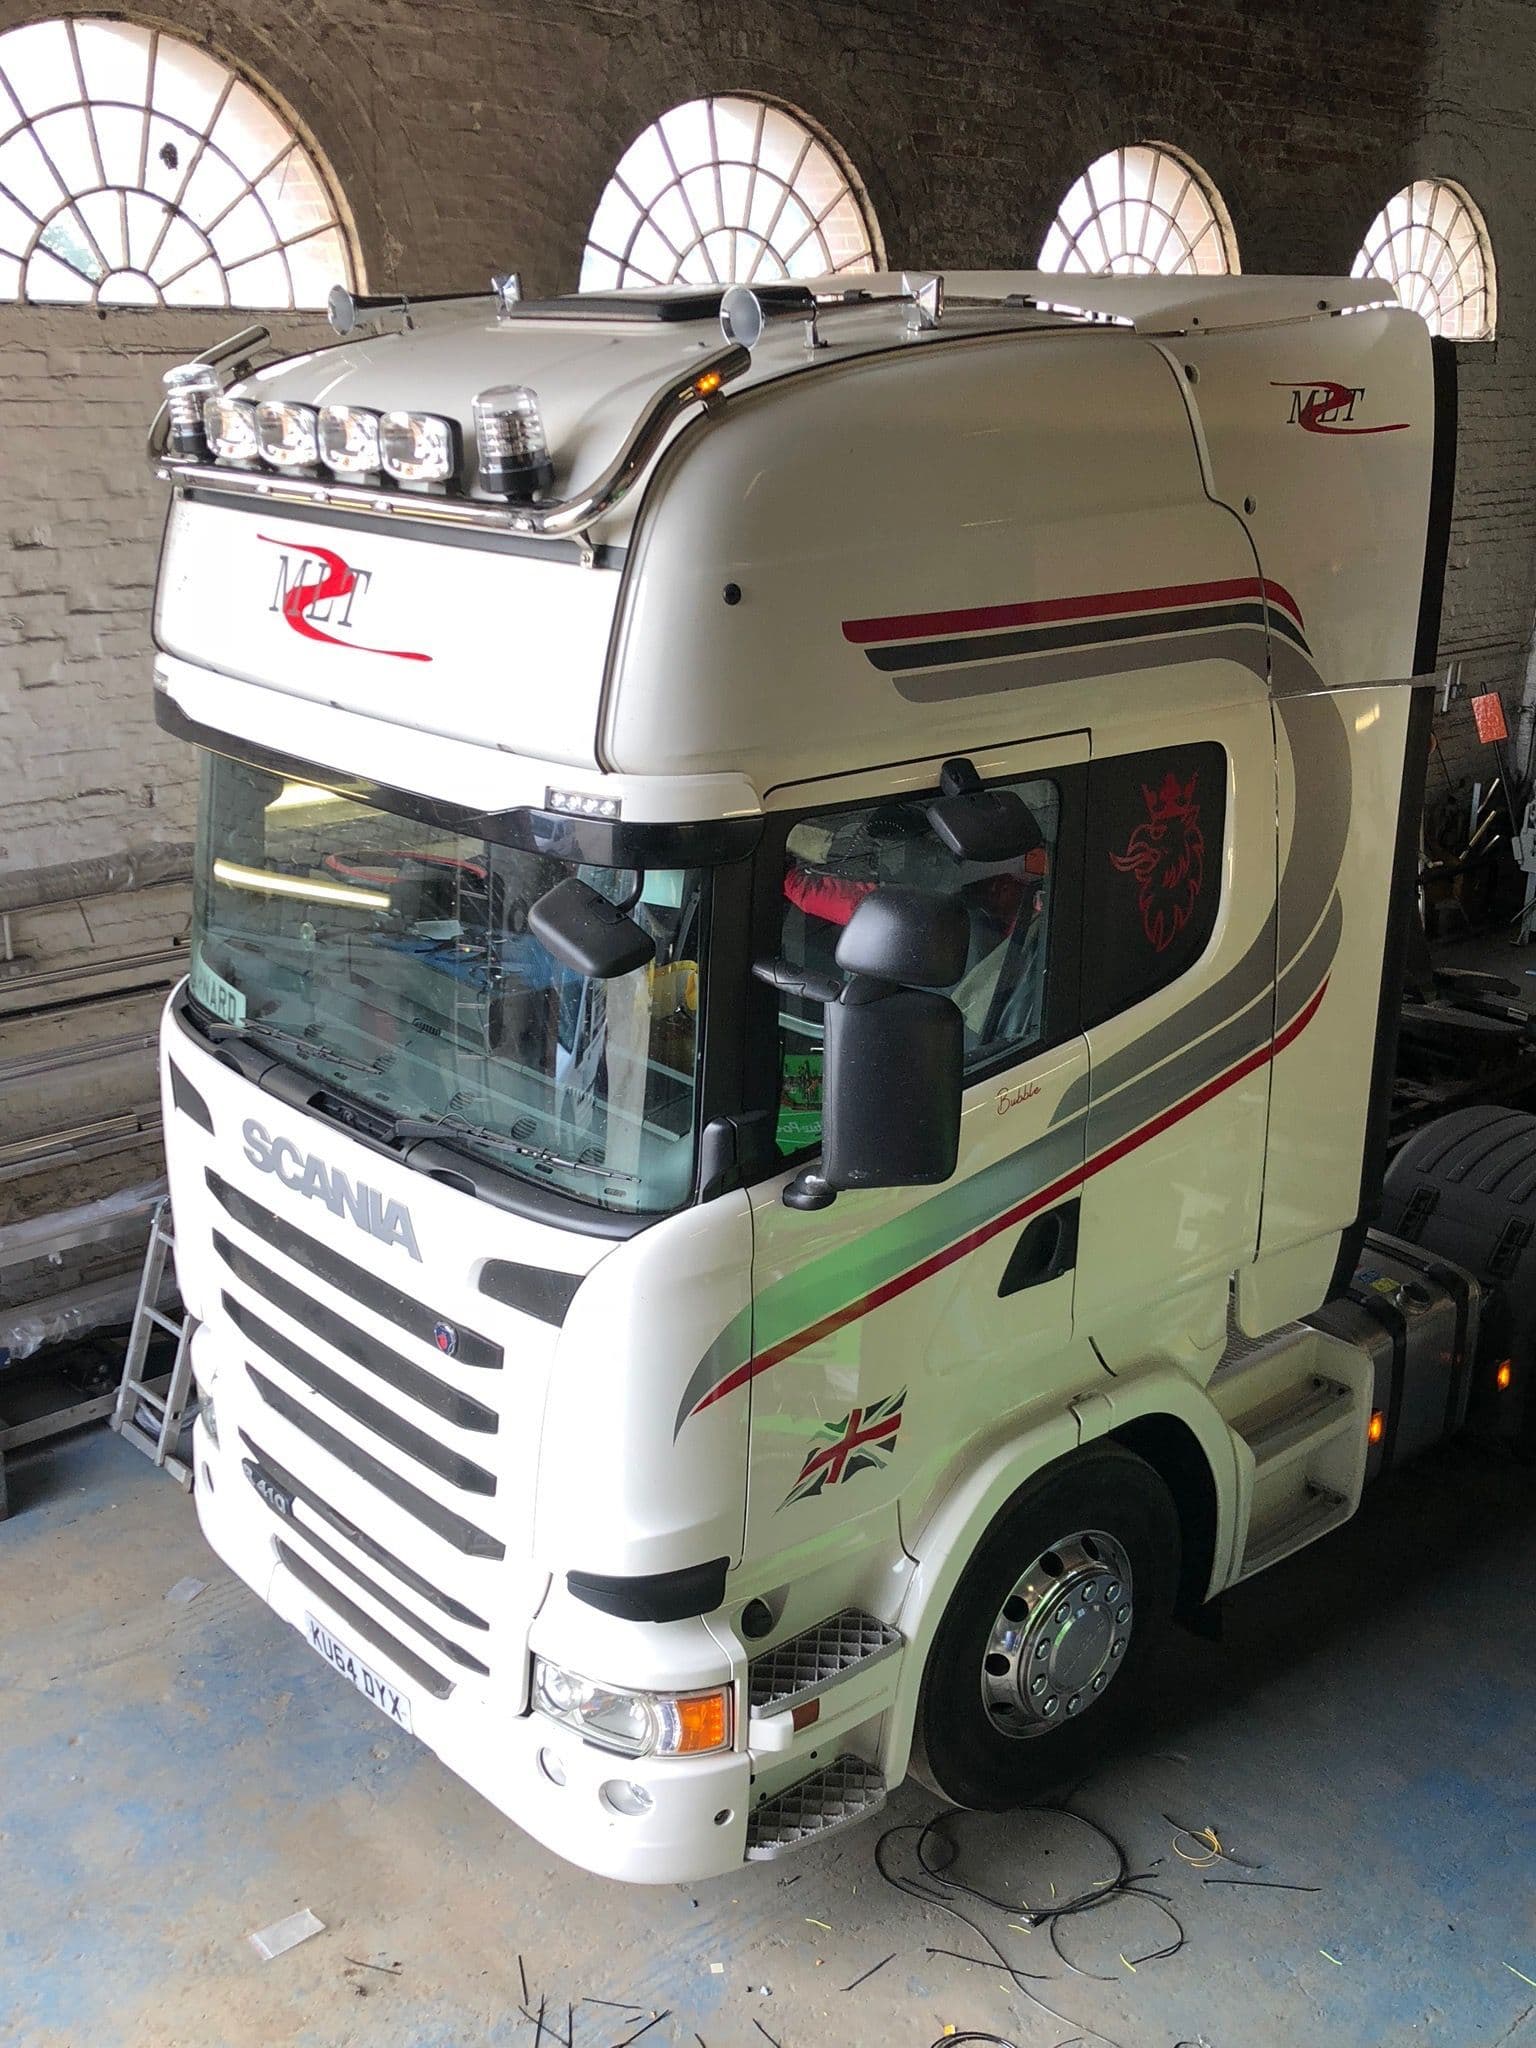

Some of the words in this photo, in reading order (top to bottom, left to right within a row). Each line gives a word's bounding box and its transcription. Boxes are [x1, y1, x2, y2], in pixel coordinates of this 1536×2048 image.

[1287, 388, 1365, 424] MLT
[269, 555, 373, 628] MLT
[996, 1083, 1042, 1116] Bubble
[242, 1117, 423, 1263] SCANIA
[256, 1479, 287, 1514] 410
[310, 1619, 357, 1681] KU64
[361, 1667, 403, 1723] DYX
